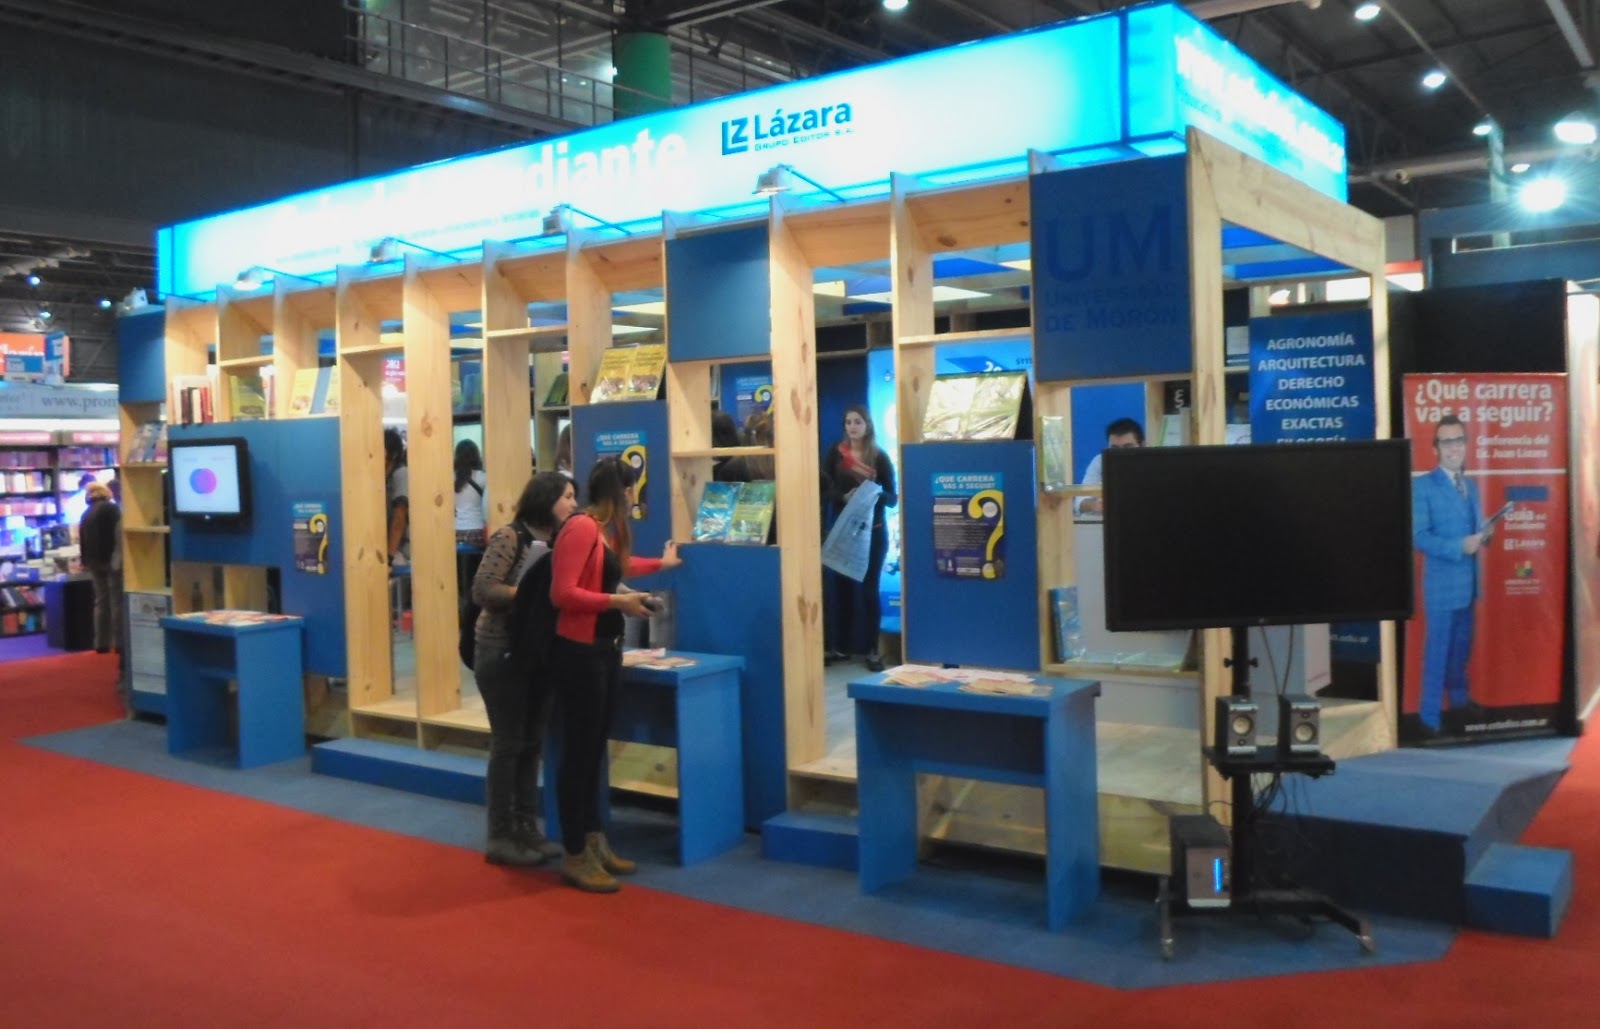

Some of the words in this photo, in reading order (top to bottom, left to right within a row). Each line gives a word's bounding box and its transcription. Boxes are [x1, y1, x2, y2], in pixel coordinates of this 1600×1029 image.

[754, 102, 852, 140] Lázara
[1047, 205, 1172, 282] UM
[1266, 332, 1355, 351] AGRONOMÍA
[1258, 354, 1366, 371] ARQUITECTURA
[1278, 376, 1345, 390] DERECHO
[1415, 378, 1470, 404] ¿Qué
[1474, 382, 1552, 400] carrera
[1265, 396, 1359, 411] ECONÓMICAS
[1458, 406, 1471, 422] a
[1476, 401, 1554, 428] seguir?
[1281, 417, 1344, 430] EXACTAS
[943, 482, 957, 490] VAS
[957, 475, 995, 483] CARRERA
